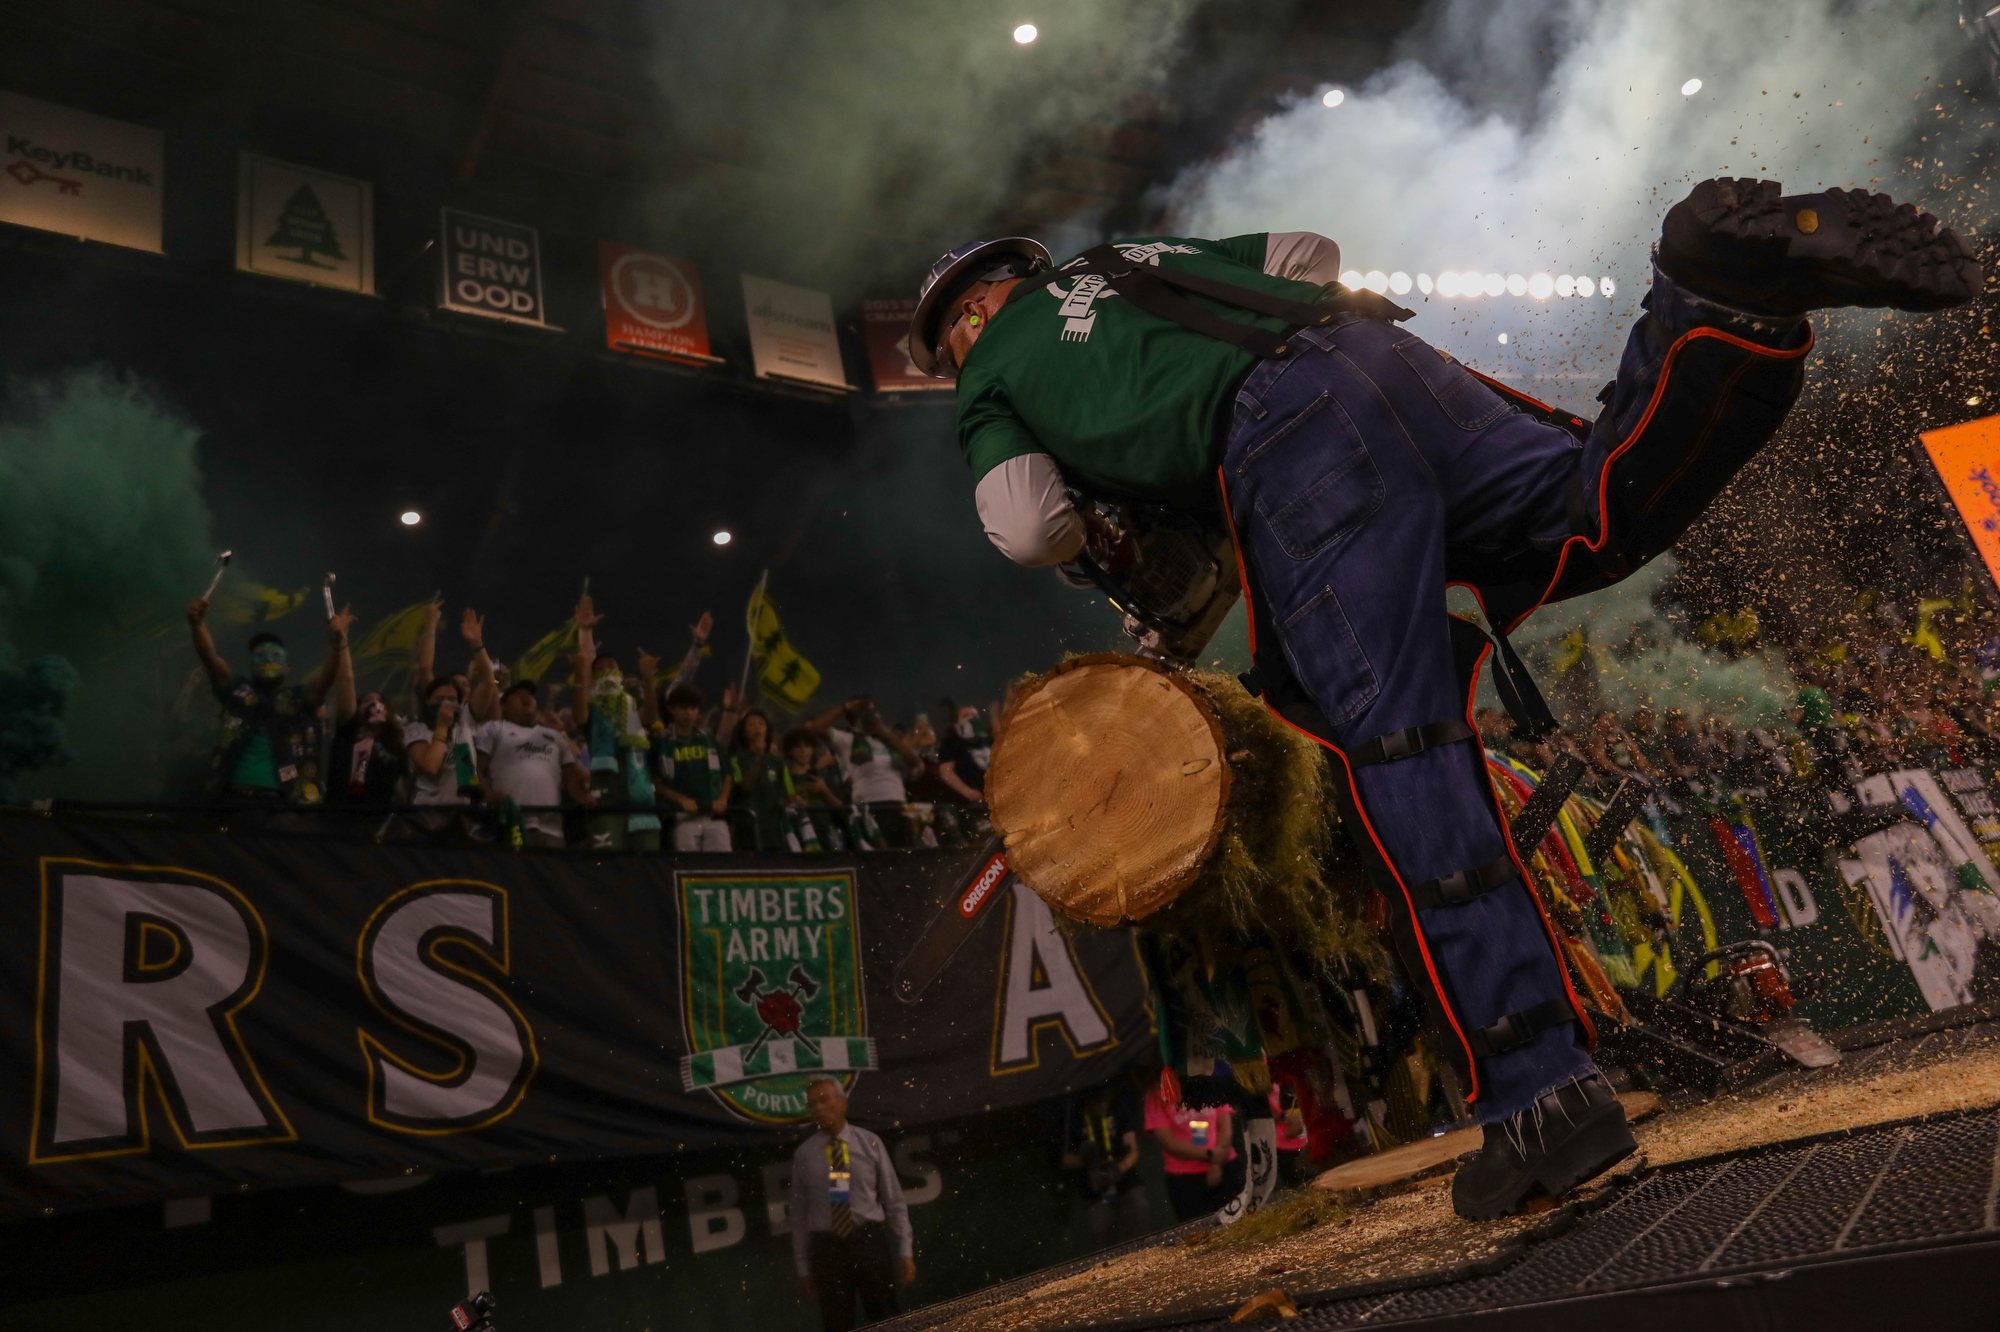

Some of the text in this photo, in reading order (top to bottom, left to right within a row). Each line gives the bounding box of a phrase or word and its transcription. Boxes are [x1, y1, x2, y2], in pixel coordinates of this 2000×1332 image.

[7, 136, 154, 186] KeyBank
[456, 225, 530, 260] UND
[1128, 244, 1161, 260] OEY
[458, 252, 531, 287] ERW
[458, 279, 534, 313] OOD
[1068, 274, 1105, 307] TIMB
[622, 323, 697, 348] HAMPTON
[962, 858, 1005, 913] OREGON
[693, 886, 845, 924] TIMBERS
[726, 925, 823, 963] ARMY
[989, 883, 1120, 1077] A
[742, 1085, 808, 1113] PORTL
[432, 1135, 943, 1301] TIMBES
